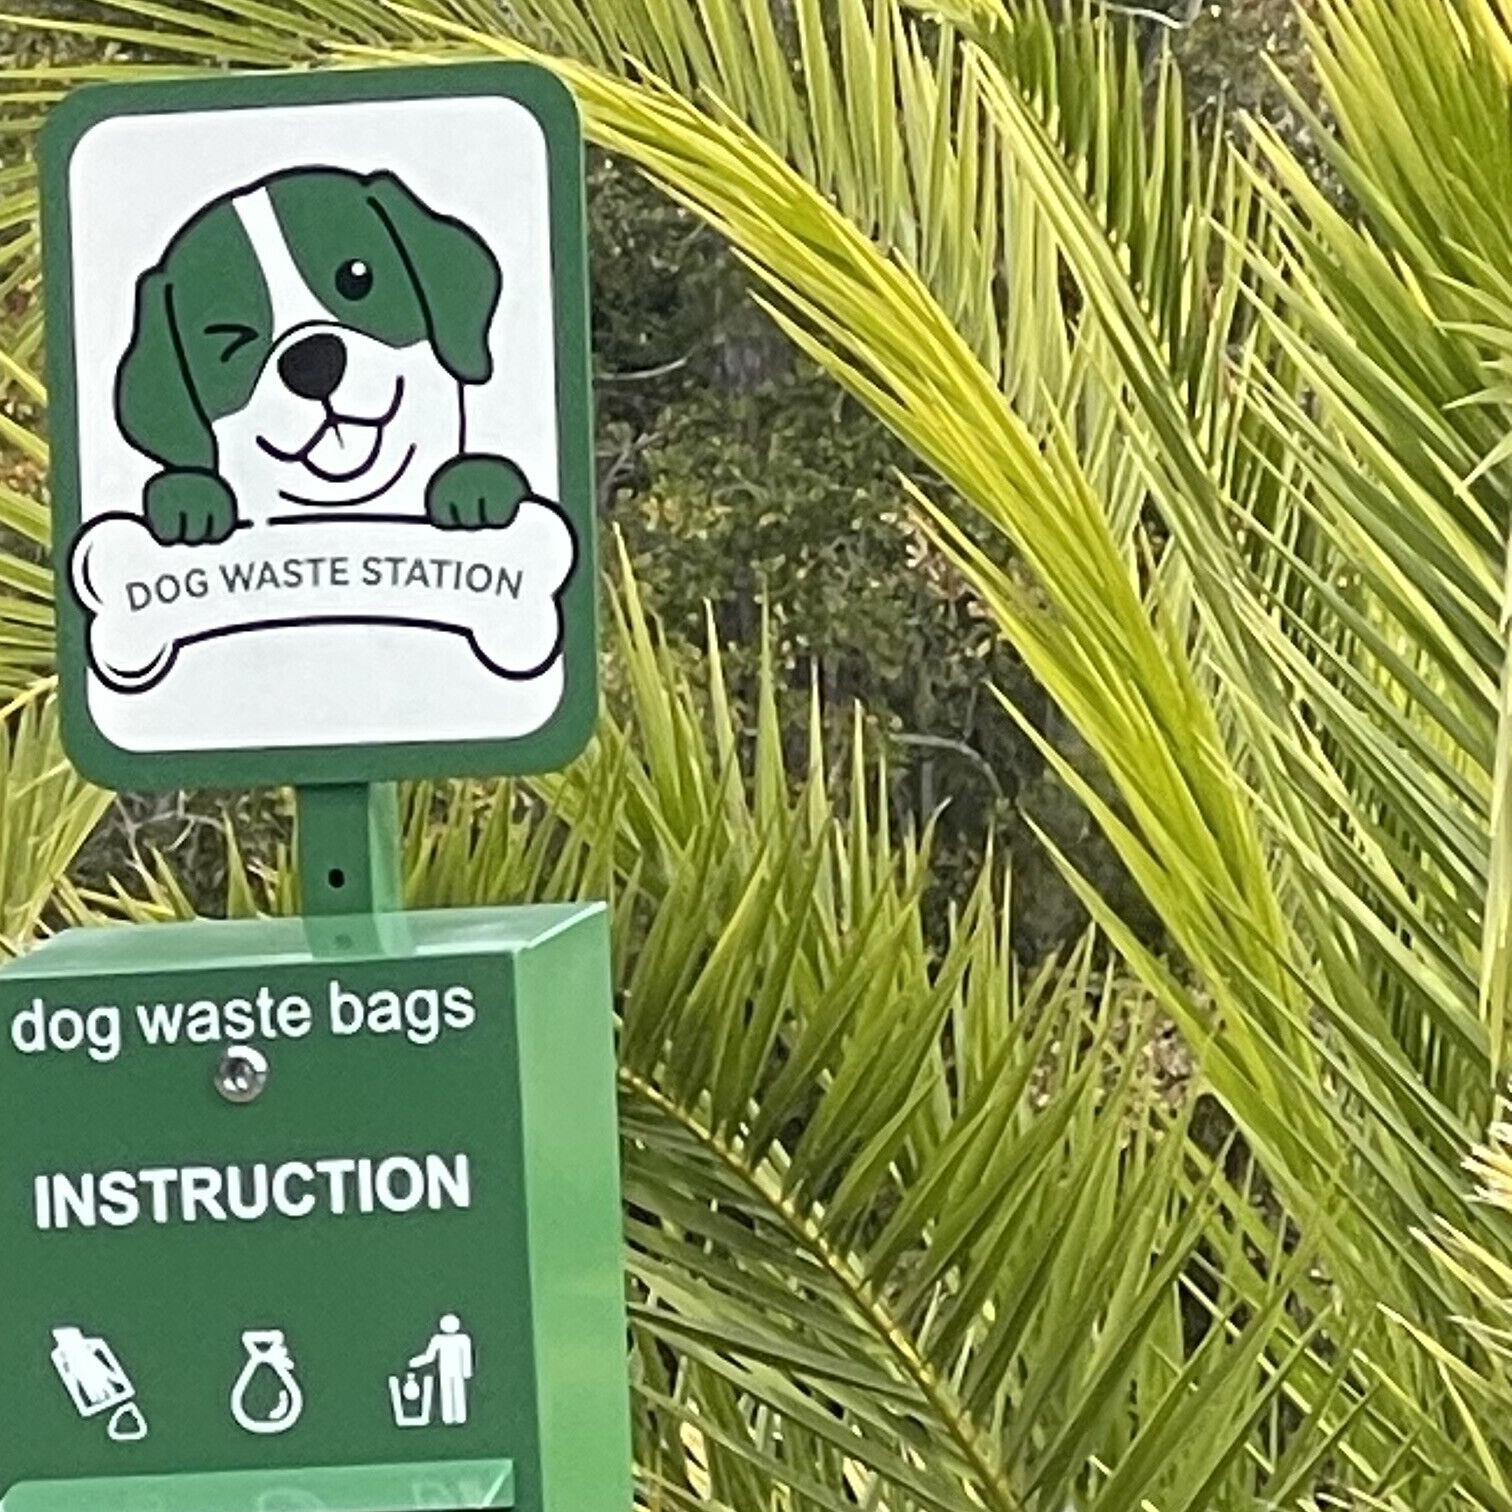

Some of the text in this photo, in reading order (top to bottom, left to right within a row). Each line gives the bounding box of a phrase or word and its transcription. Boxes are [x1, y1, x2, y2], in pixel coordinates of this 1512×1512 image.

[125, 555, 524, 612] DOG WASTE STATION
[11, 980, 476, 1061] dog waste bags
[34, 1154, 471, 1230] INSTRUCTION
